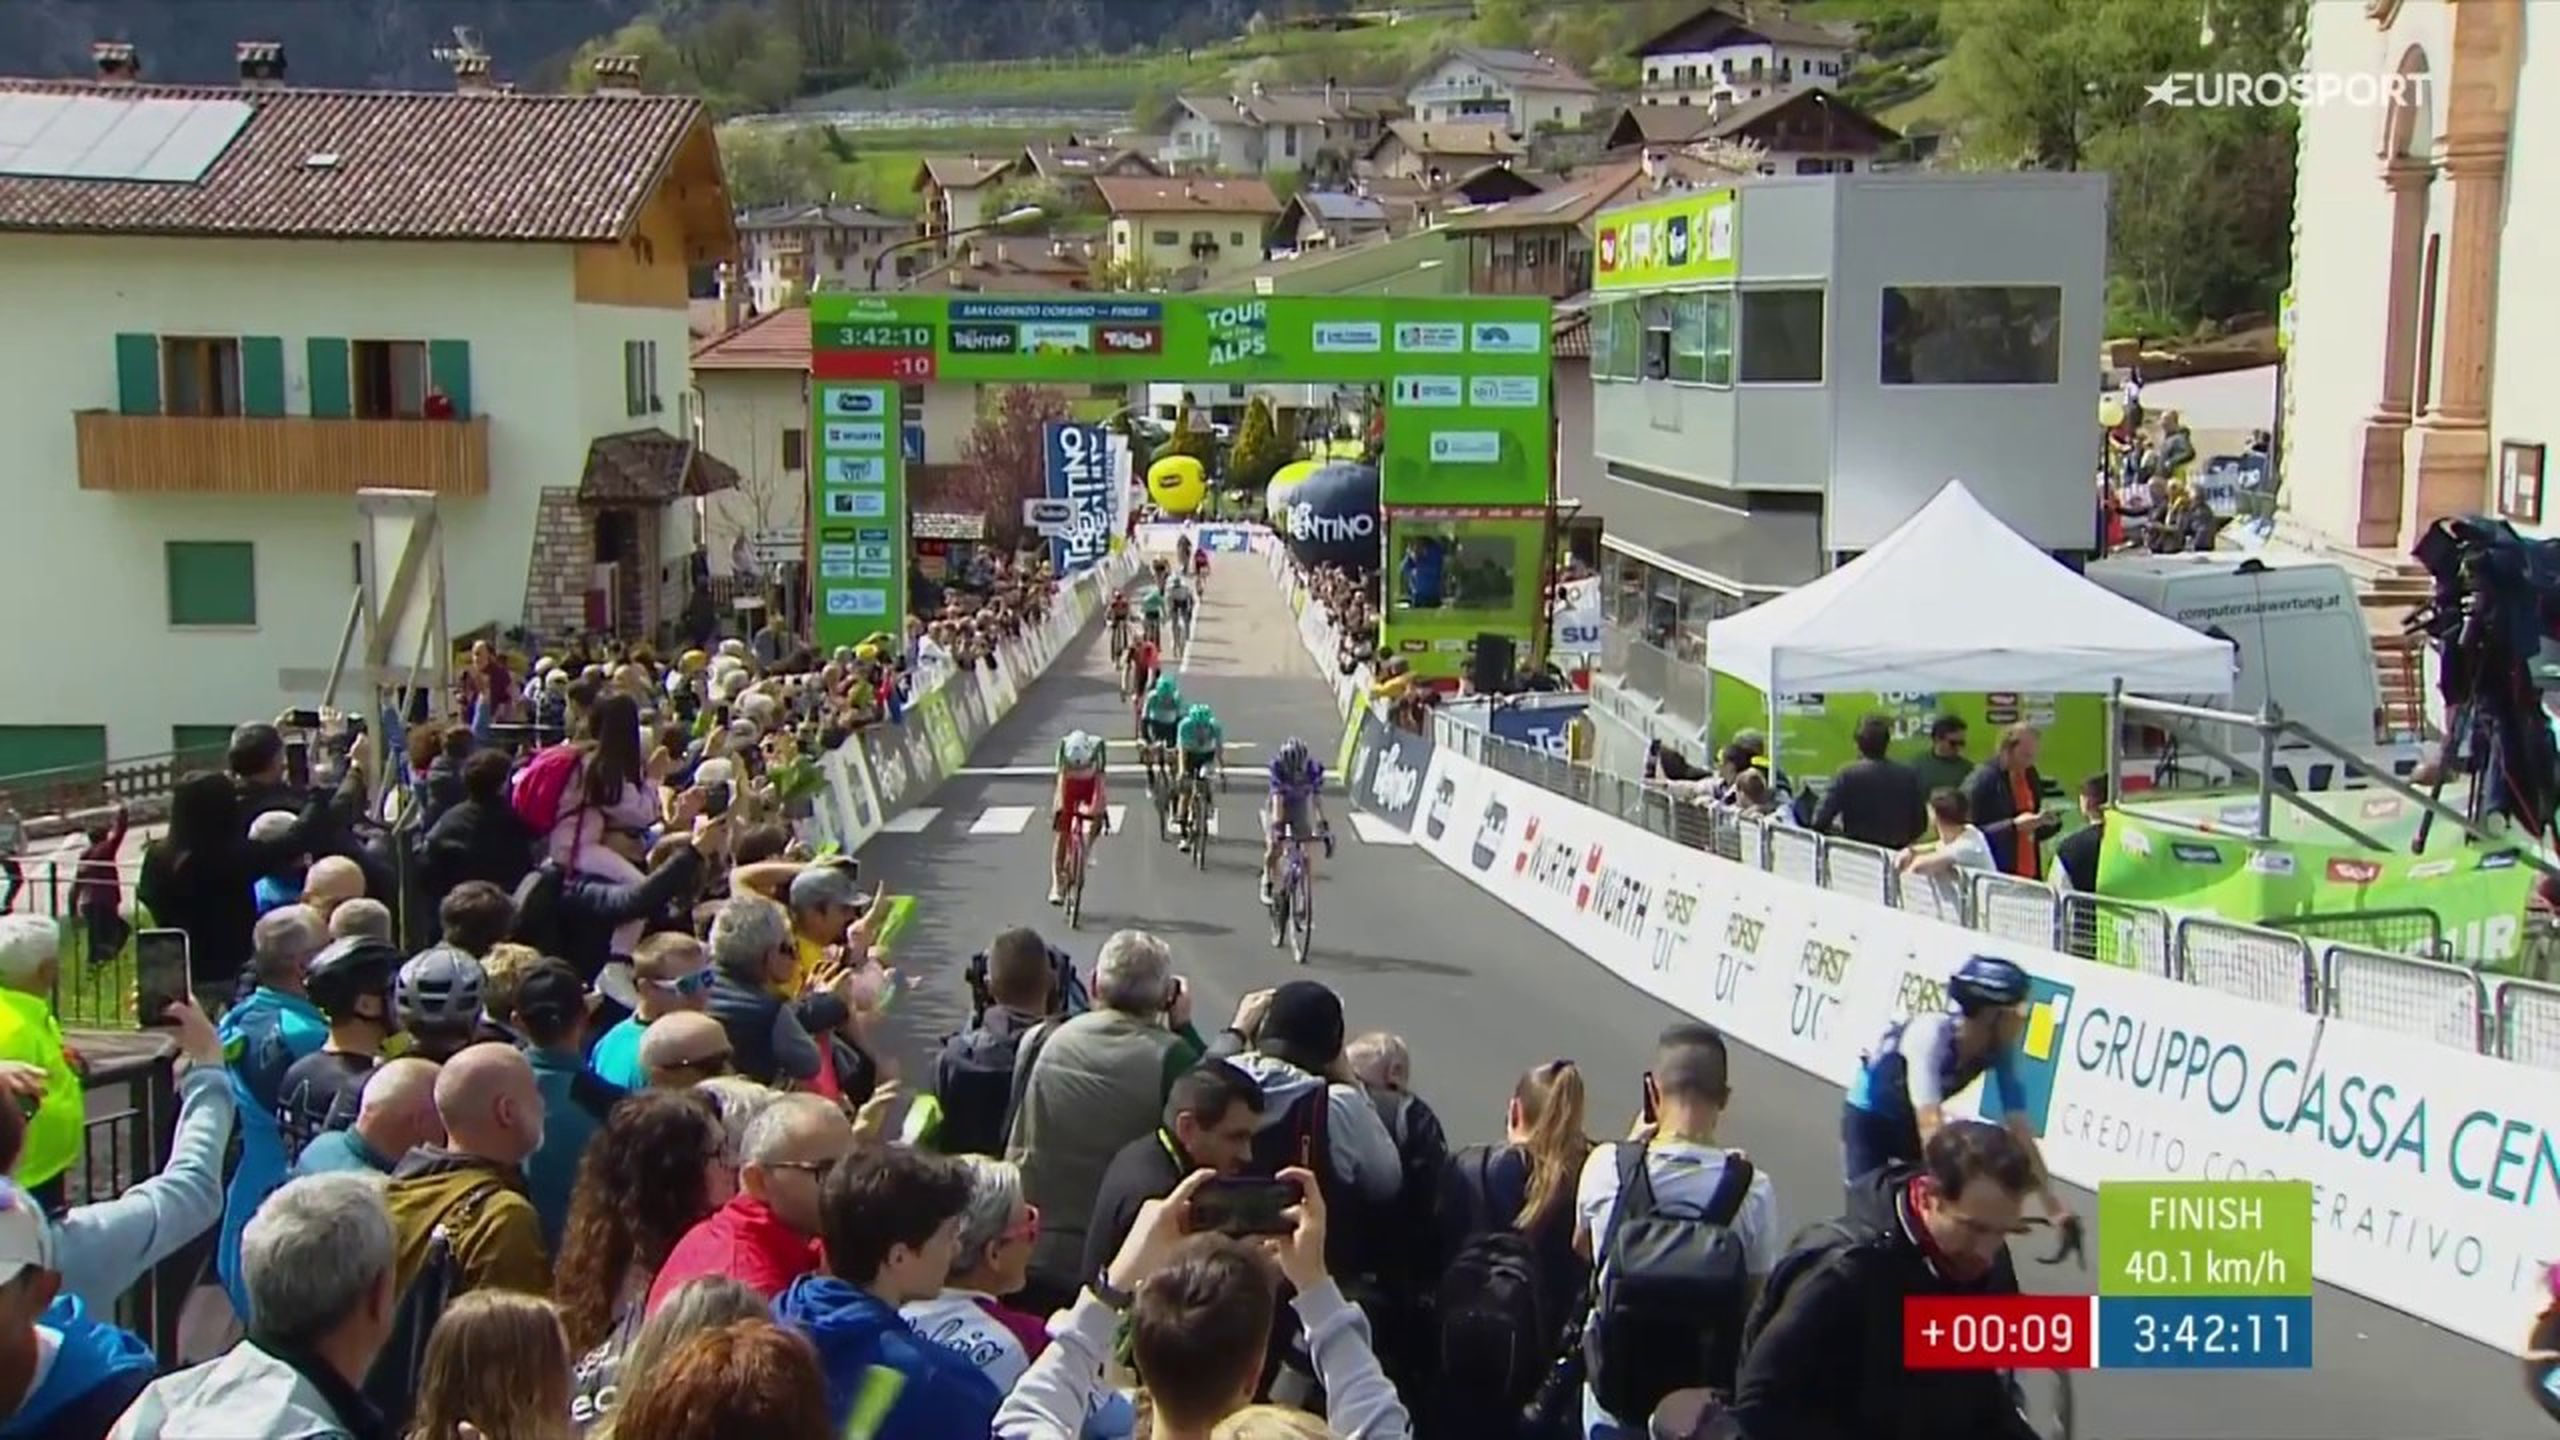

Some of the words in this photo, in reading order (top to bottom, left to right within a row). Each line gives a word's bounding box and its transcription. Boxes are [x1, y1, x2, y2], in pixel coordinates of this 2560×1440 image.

[963, 304, 986, 316] SAN
[988, 304, 1040, 316] LORENZO
[1111, 305, 1149, 316] FINISH
[1207, 301, 1267, 330] TOUR
[840, 328, 930, 347] 3:42:10
[1208, 334, 1266, 368] ALPS
[2177, 594, 2340, 620] computerauswertung.at
[2076, 1007, 2249, 1114] GRUPPO
[2258, 1059, 2426, 1173] CASSA
[2061, 1103, 2186, 1173] CREDITO
